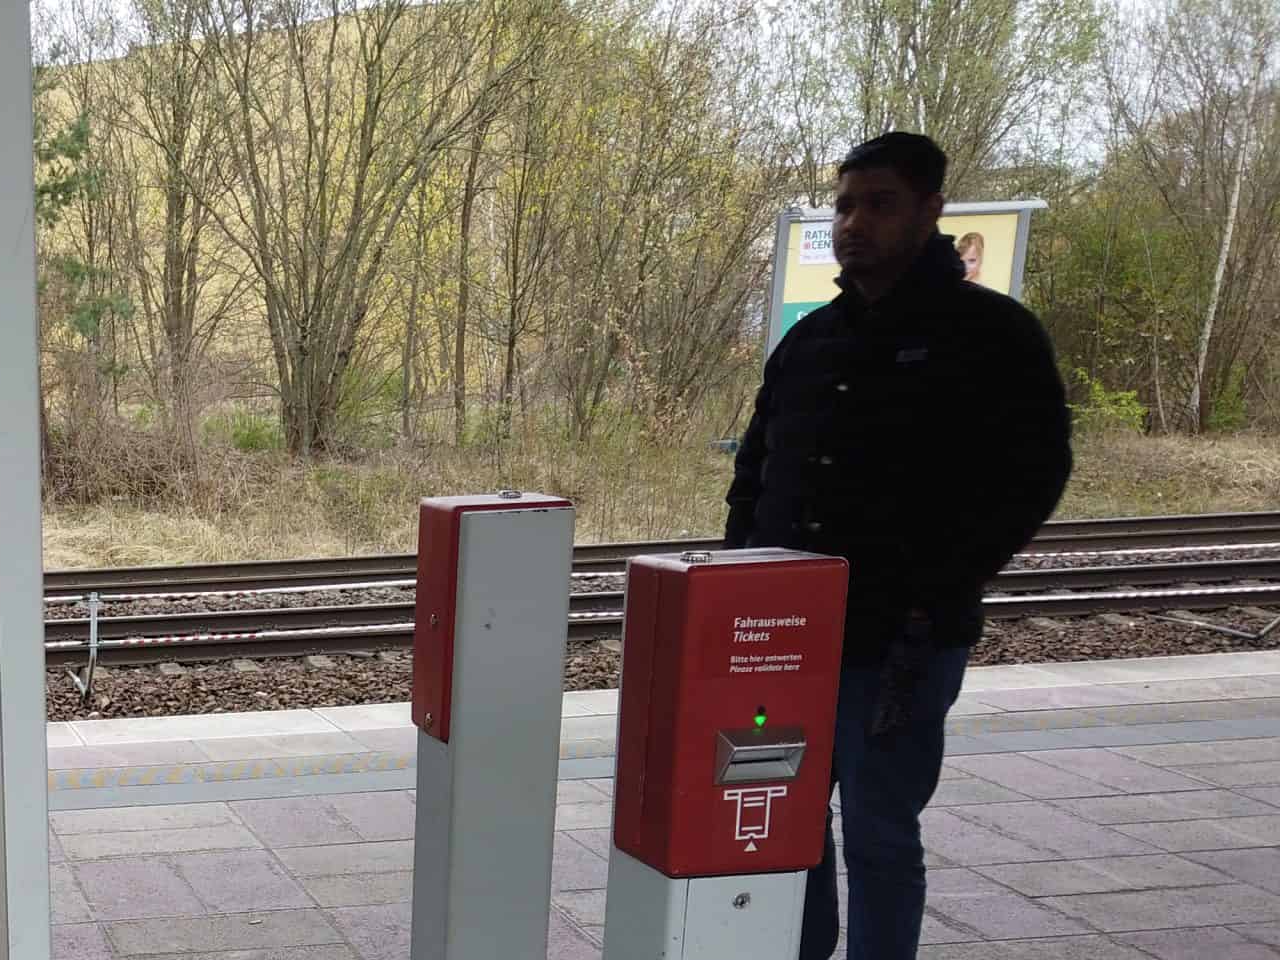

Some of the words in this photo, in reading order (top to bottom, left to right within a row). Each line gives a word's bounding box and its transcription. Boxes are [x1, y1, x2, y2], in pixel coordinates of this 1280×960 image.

[804, 230, 832, 241] RATH
[812, 240, 834, 250] CEN
[733, 616, 807, 629] Fahrausweise
[733, 631, 770, 643] Tickets
[730, 655, 749, 664] Bitte
[749, 654, 764, 663] hier
[765, 653, 802, 662] entwerten
[729, 664, 753, 673] Please
[754, 664, 783, 672] validate
[784, 663, 801, 671] here
